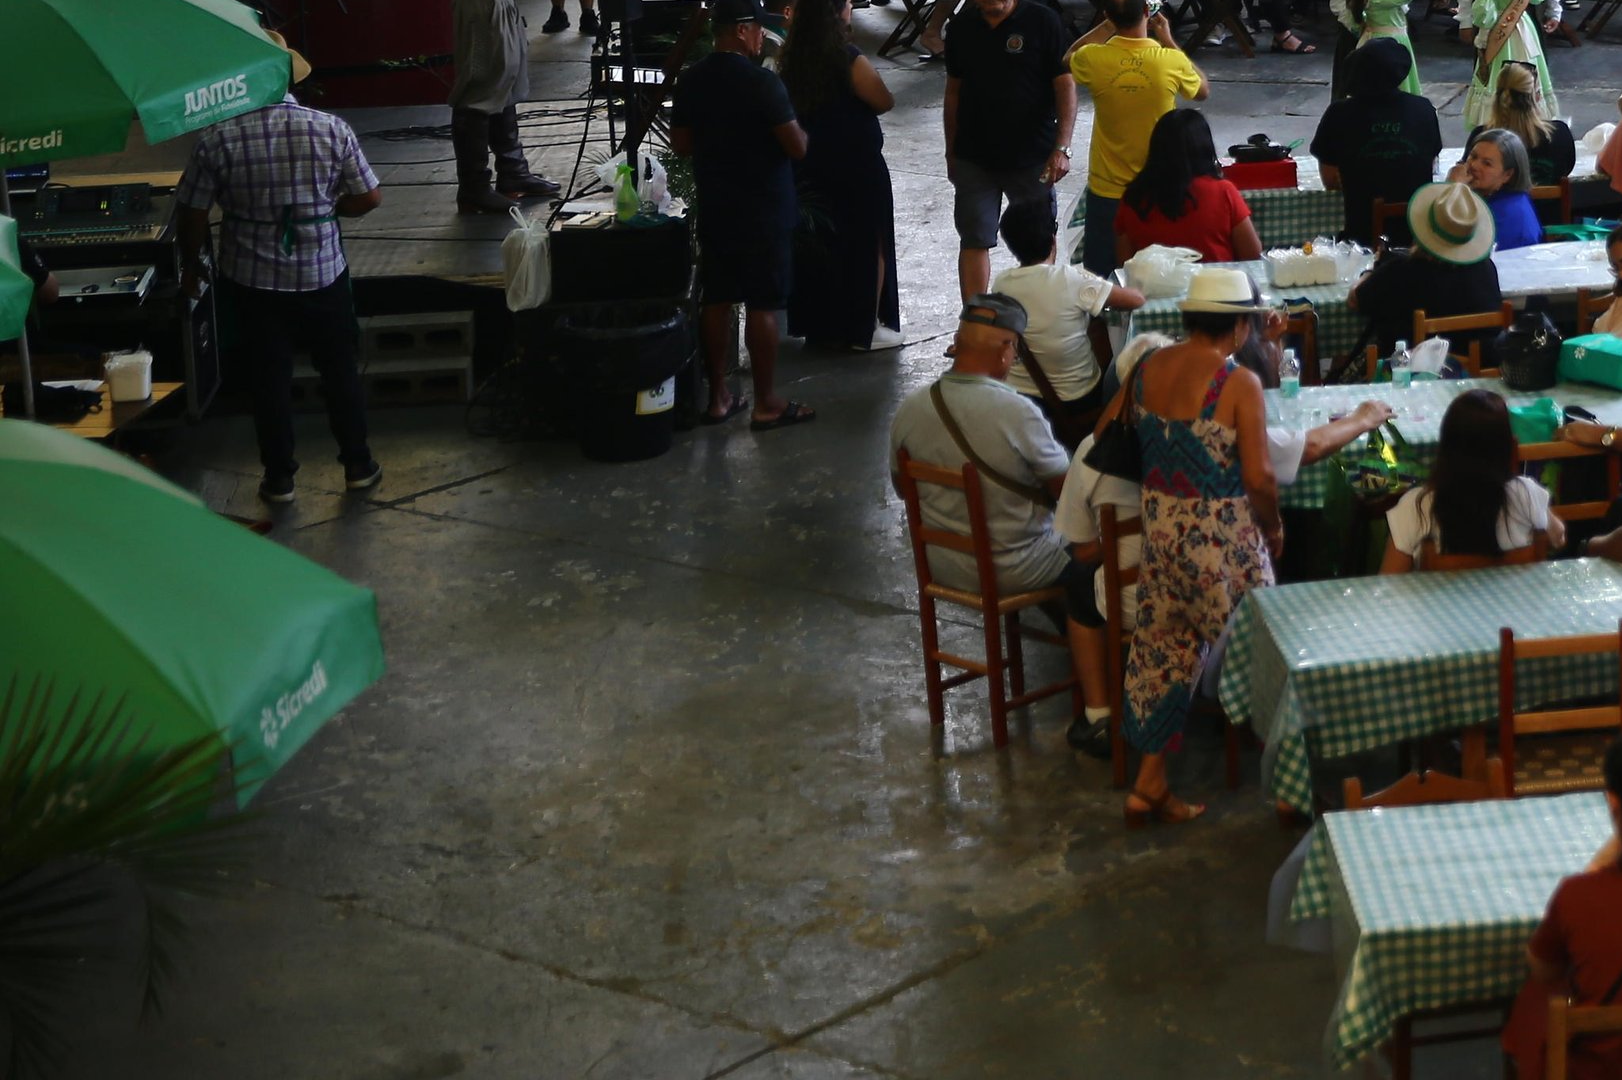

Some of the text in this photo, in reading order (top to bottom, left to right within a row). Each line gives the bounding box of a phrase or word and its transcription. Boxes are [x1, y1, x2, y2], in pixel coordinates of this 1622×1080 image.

[184, 74, 247, 116] JUNTOS
[0, 130, 63, 155] icredi
[276, 659, 328, 730] Sicredi
